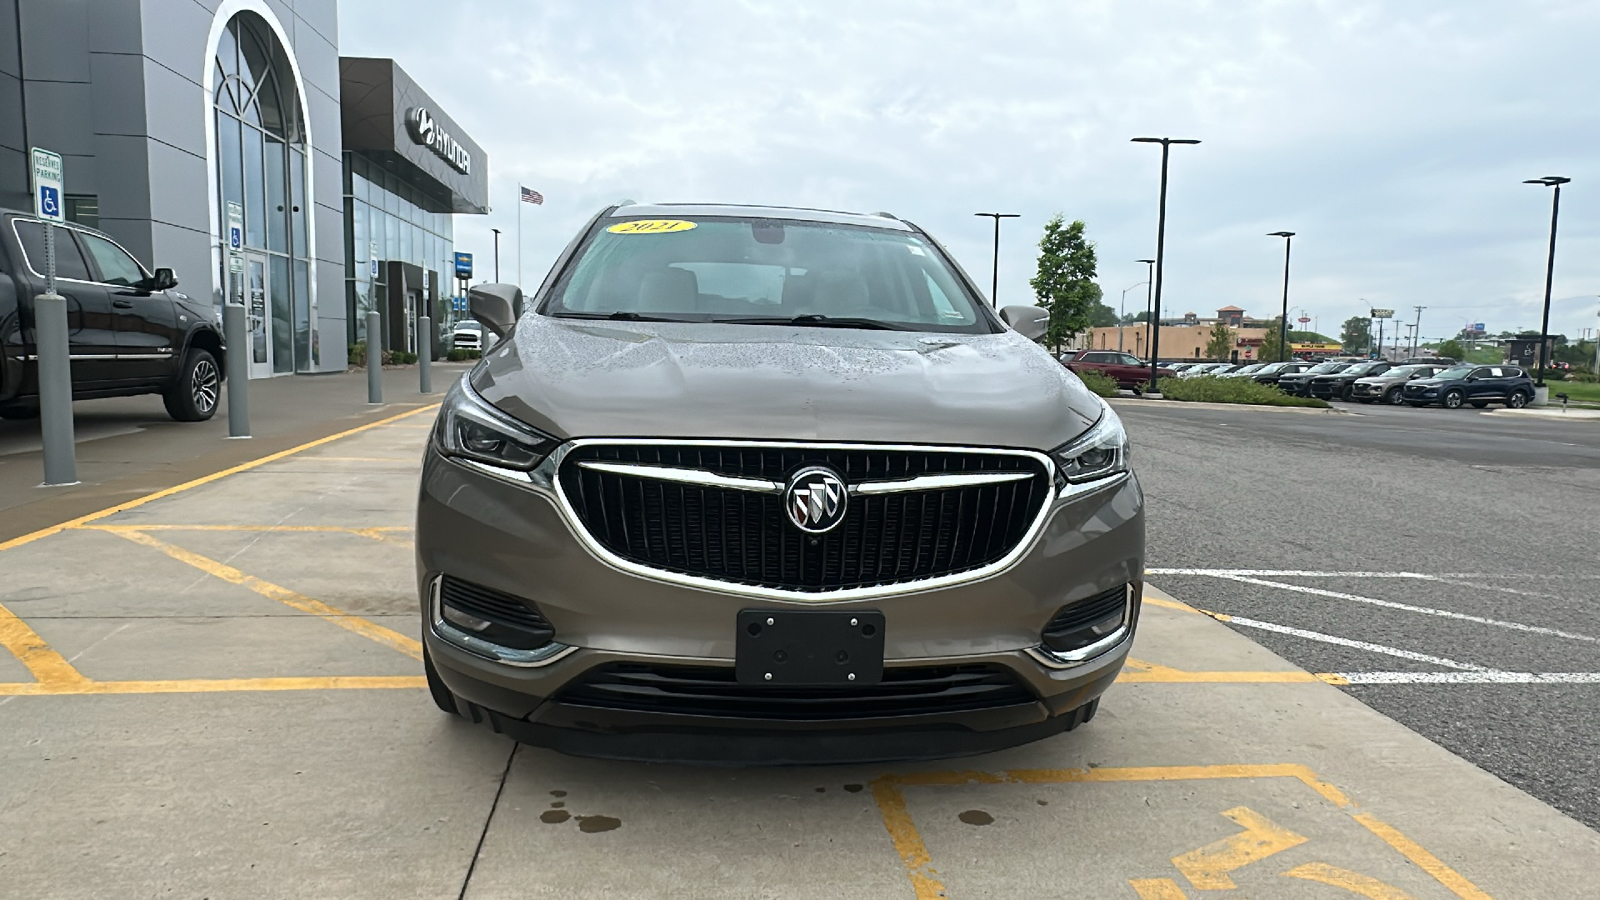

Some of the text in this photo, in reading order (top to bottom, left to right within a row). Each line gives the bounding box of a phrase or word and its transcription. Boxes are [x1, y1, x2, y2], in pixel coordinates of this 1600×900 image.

[436, 124, 470, 175] HYUNDAI
[35, 155, 60, 170] RESERVED
[36, 168, 60, 182] PARKING
[620, 222, 682, 232] 2021
